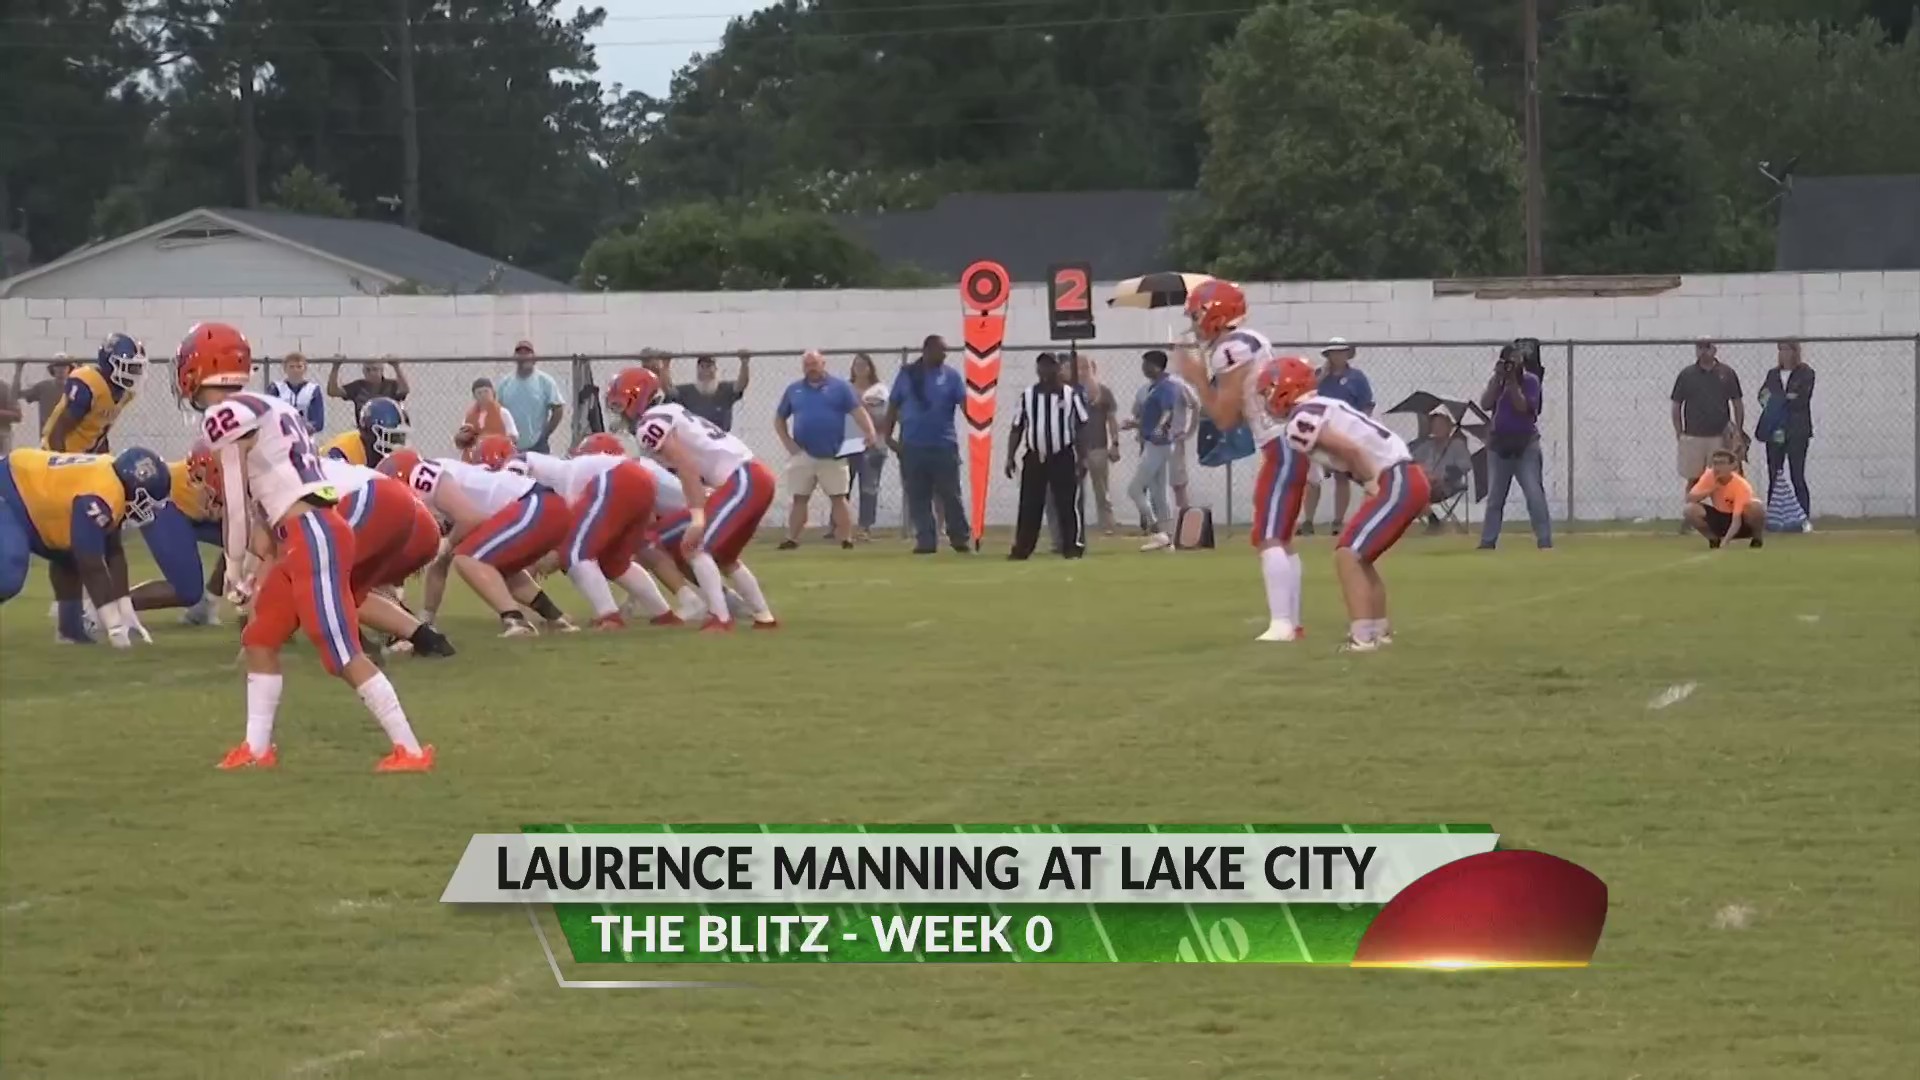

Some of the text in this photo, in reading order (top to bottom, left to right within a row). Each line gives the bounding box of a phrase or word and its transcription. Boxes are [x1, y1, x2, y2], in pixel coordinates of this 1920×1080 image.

[1054, 269, 1087, 311] 2
[1224, 348, 1236, 368] 1
[68, 384, 79, 401] 1
[204, 407, 241, 444] 22
[641, 423, 666, 449] 30
[1290, 419, 1317, 447] 14
[414, 466, 438, 493] 57
